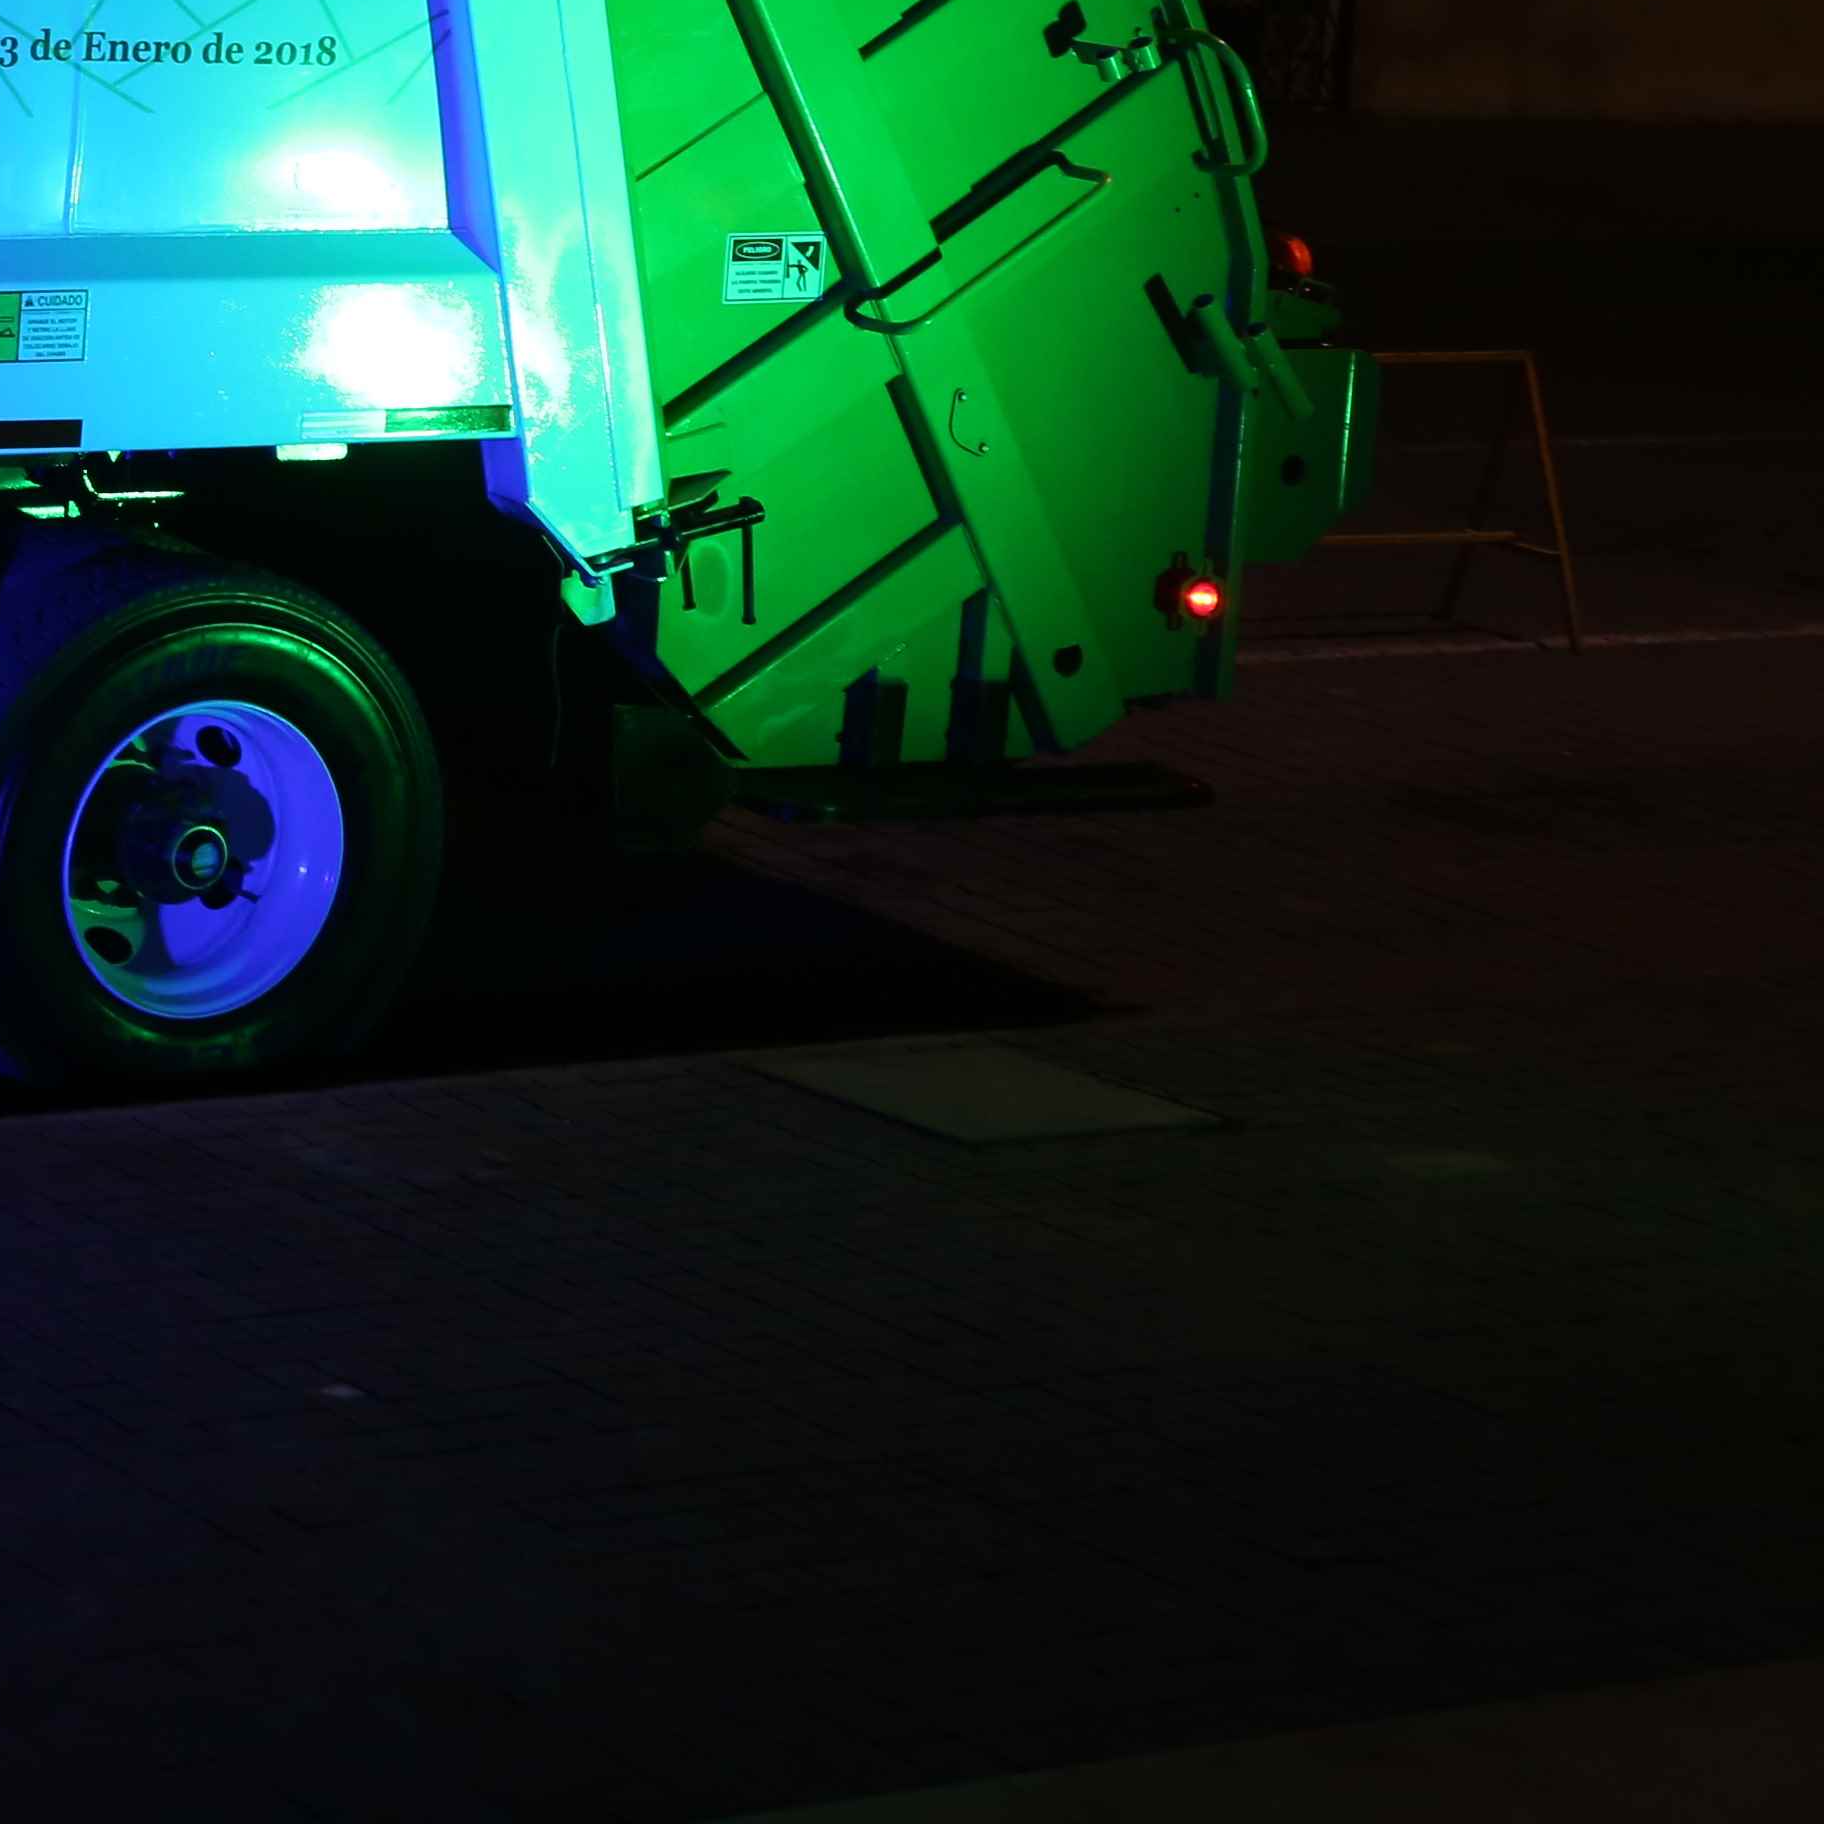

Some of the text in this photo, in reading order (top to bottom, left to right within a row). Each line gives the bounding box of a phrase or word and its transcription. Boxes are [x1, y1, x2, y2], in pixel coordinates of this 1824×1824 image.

[30, 30, 73, 62] de
[82, 32, 192, 65] Enero
[202, 32, 244, 65] de
[253, 36, 337, 67] 2018
[38, 295, 83, 306] CUIDADO
